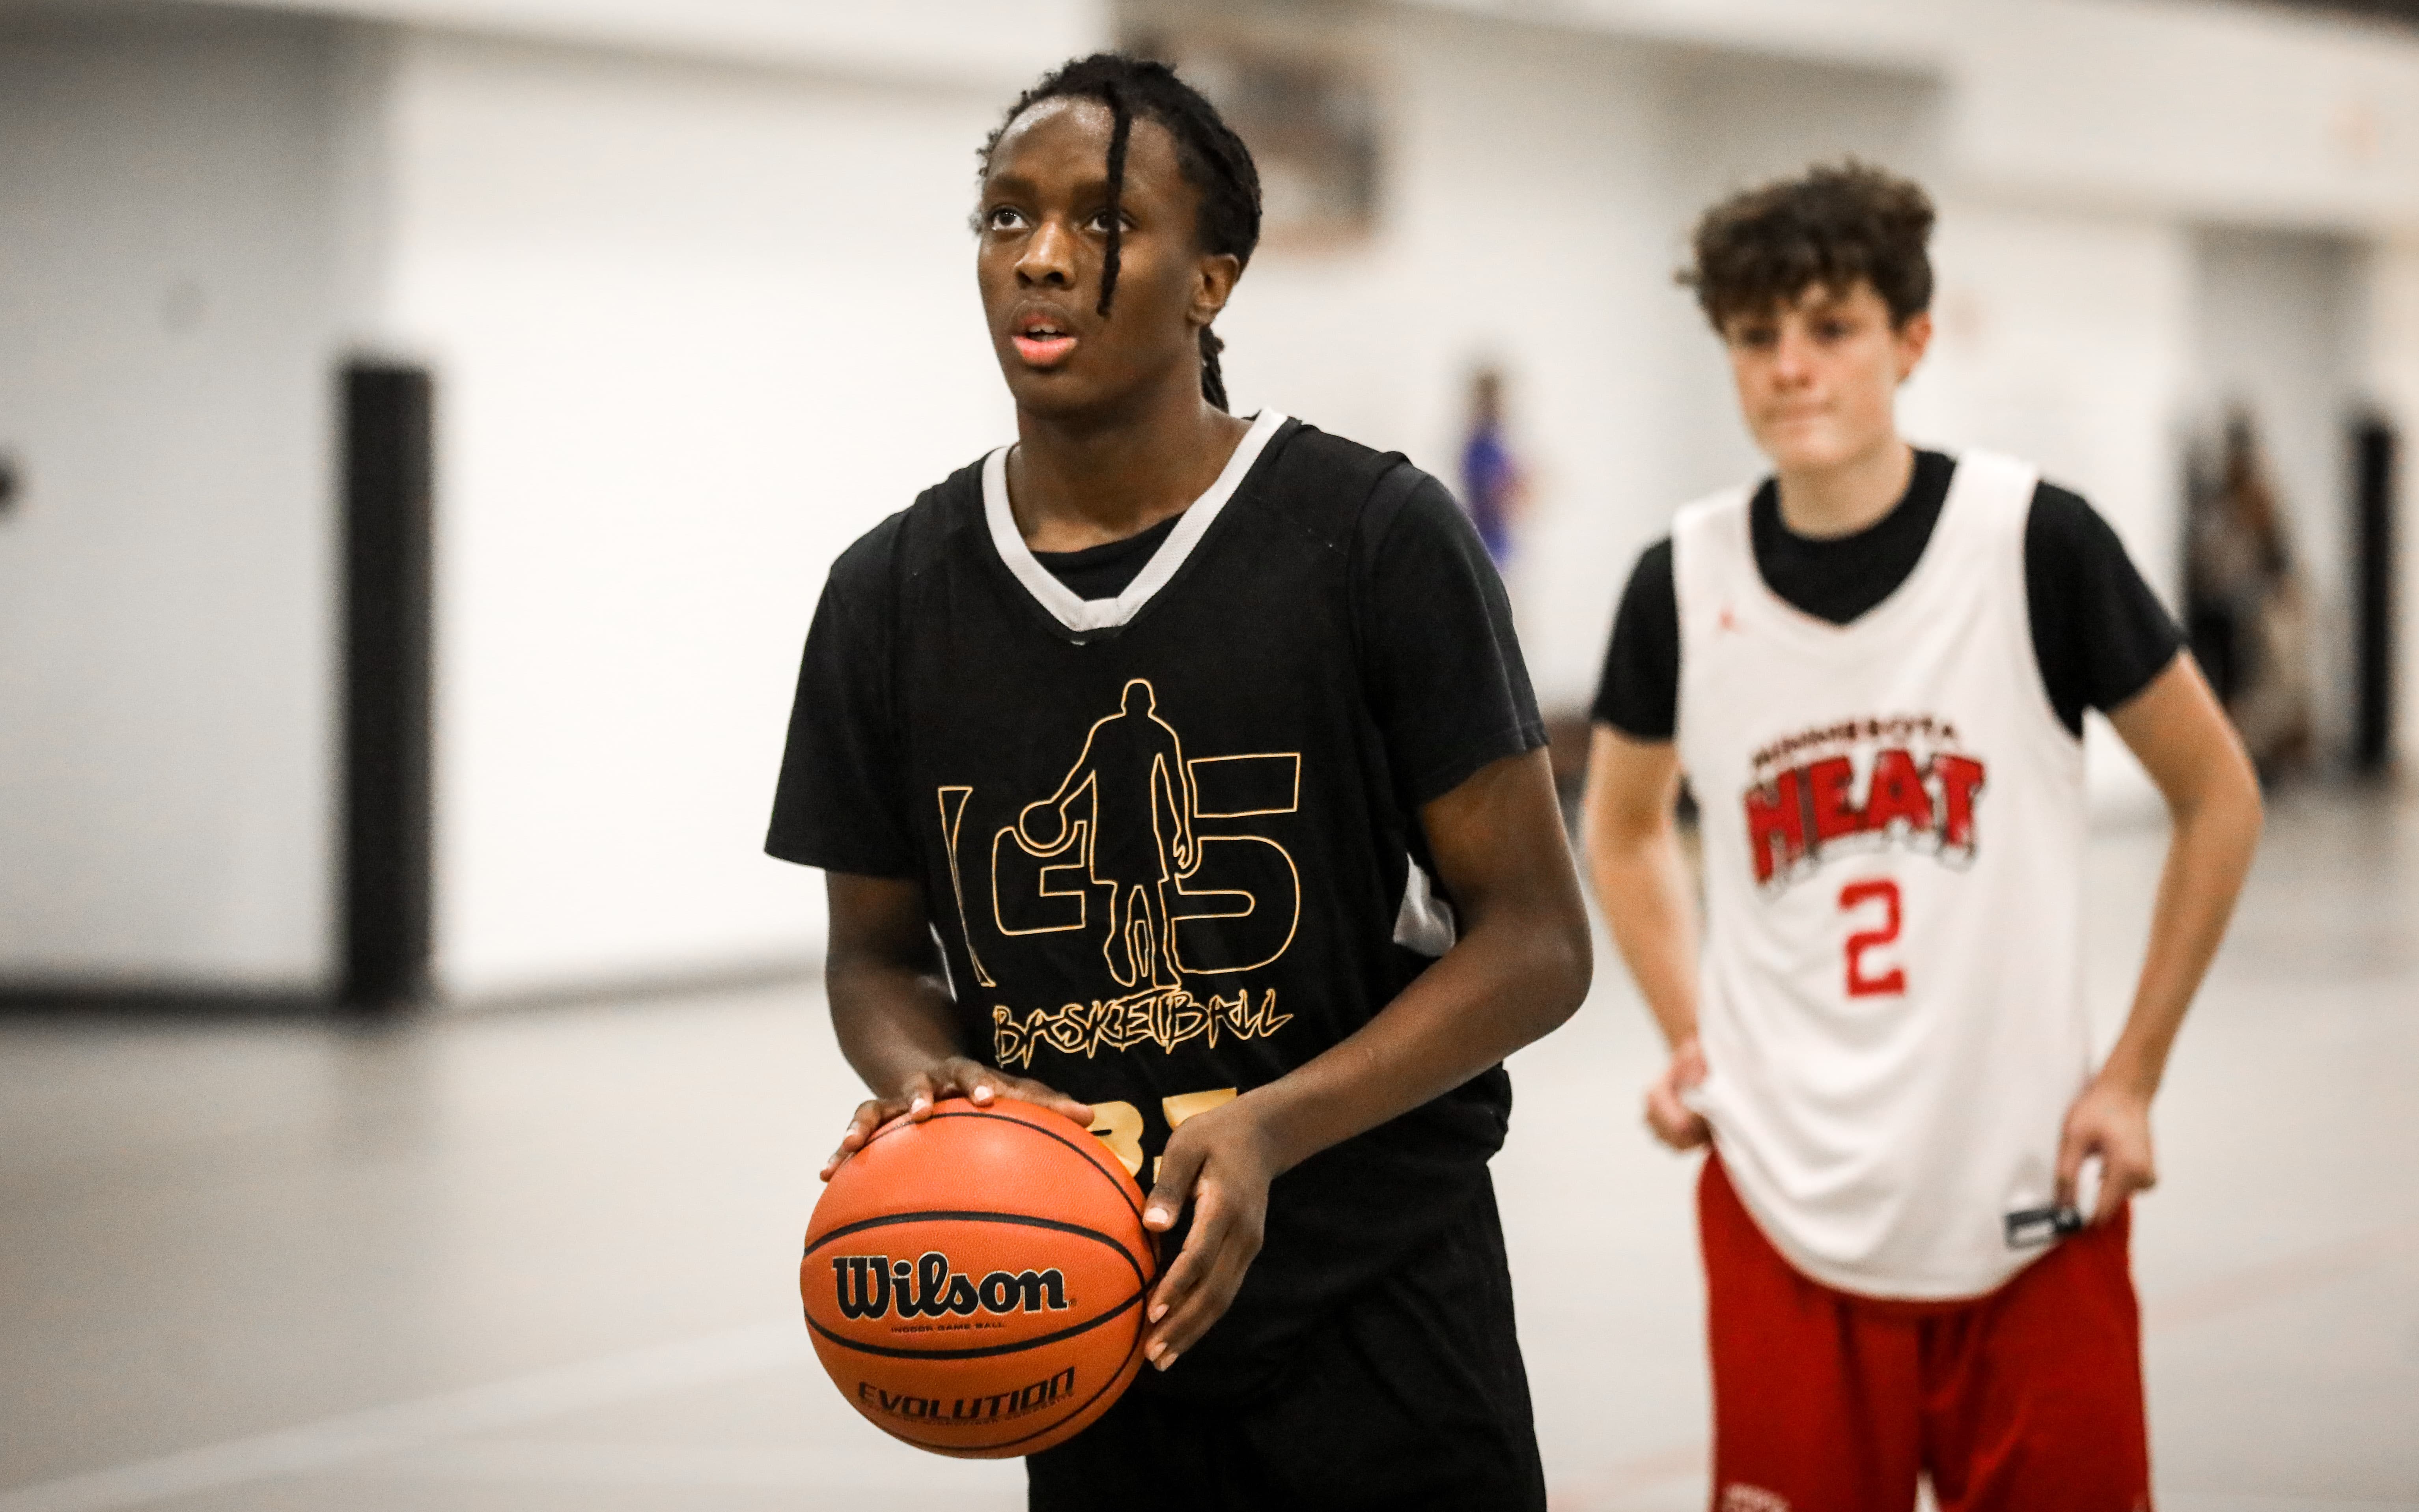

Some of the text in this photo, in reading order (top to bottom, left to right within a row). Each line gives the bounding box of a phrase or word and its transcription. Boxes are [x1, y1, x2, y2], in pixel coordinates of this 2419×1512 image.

[1743, 747, 1987, 892] HEAT
[1838, 879, 1908, 1000] 2
[993, 989, 1294, 1070] BASKETBALL
[832, 1251, 1069, 1320] Wilson
[891, 1325, 933, 1333] INDOOR
[937, 1323, 971, 1331] GAME
[859, 1366, 1075, 1419] EVOLUTION
